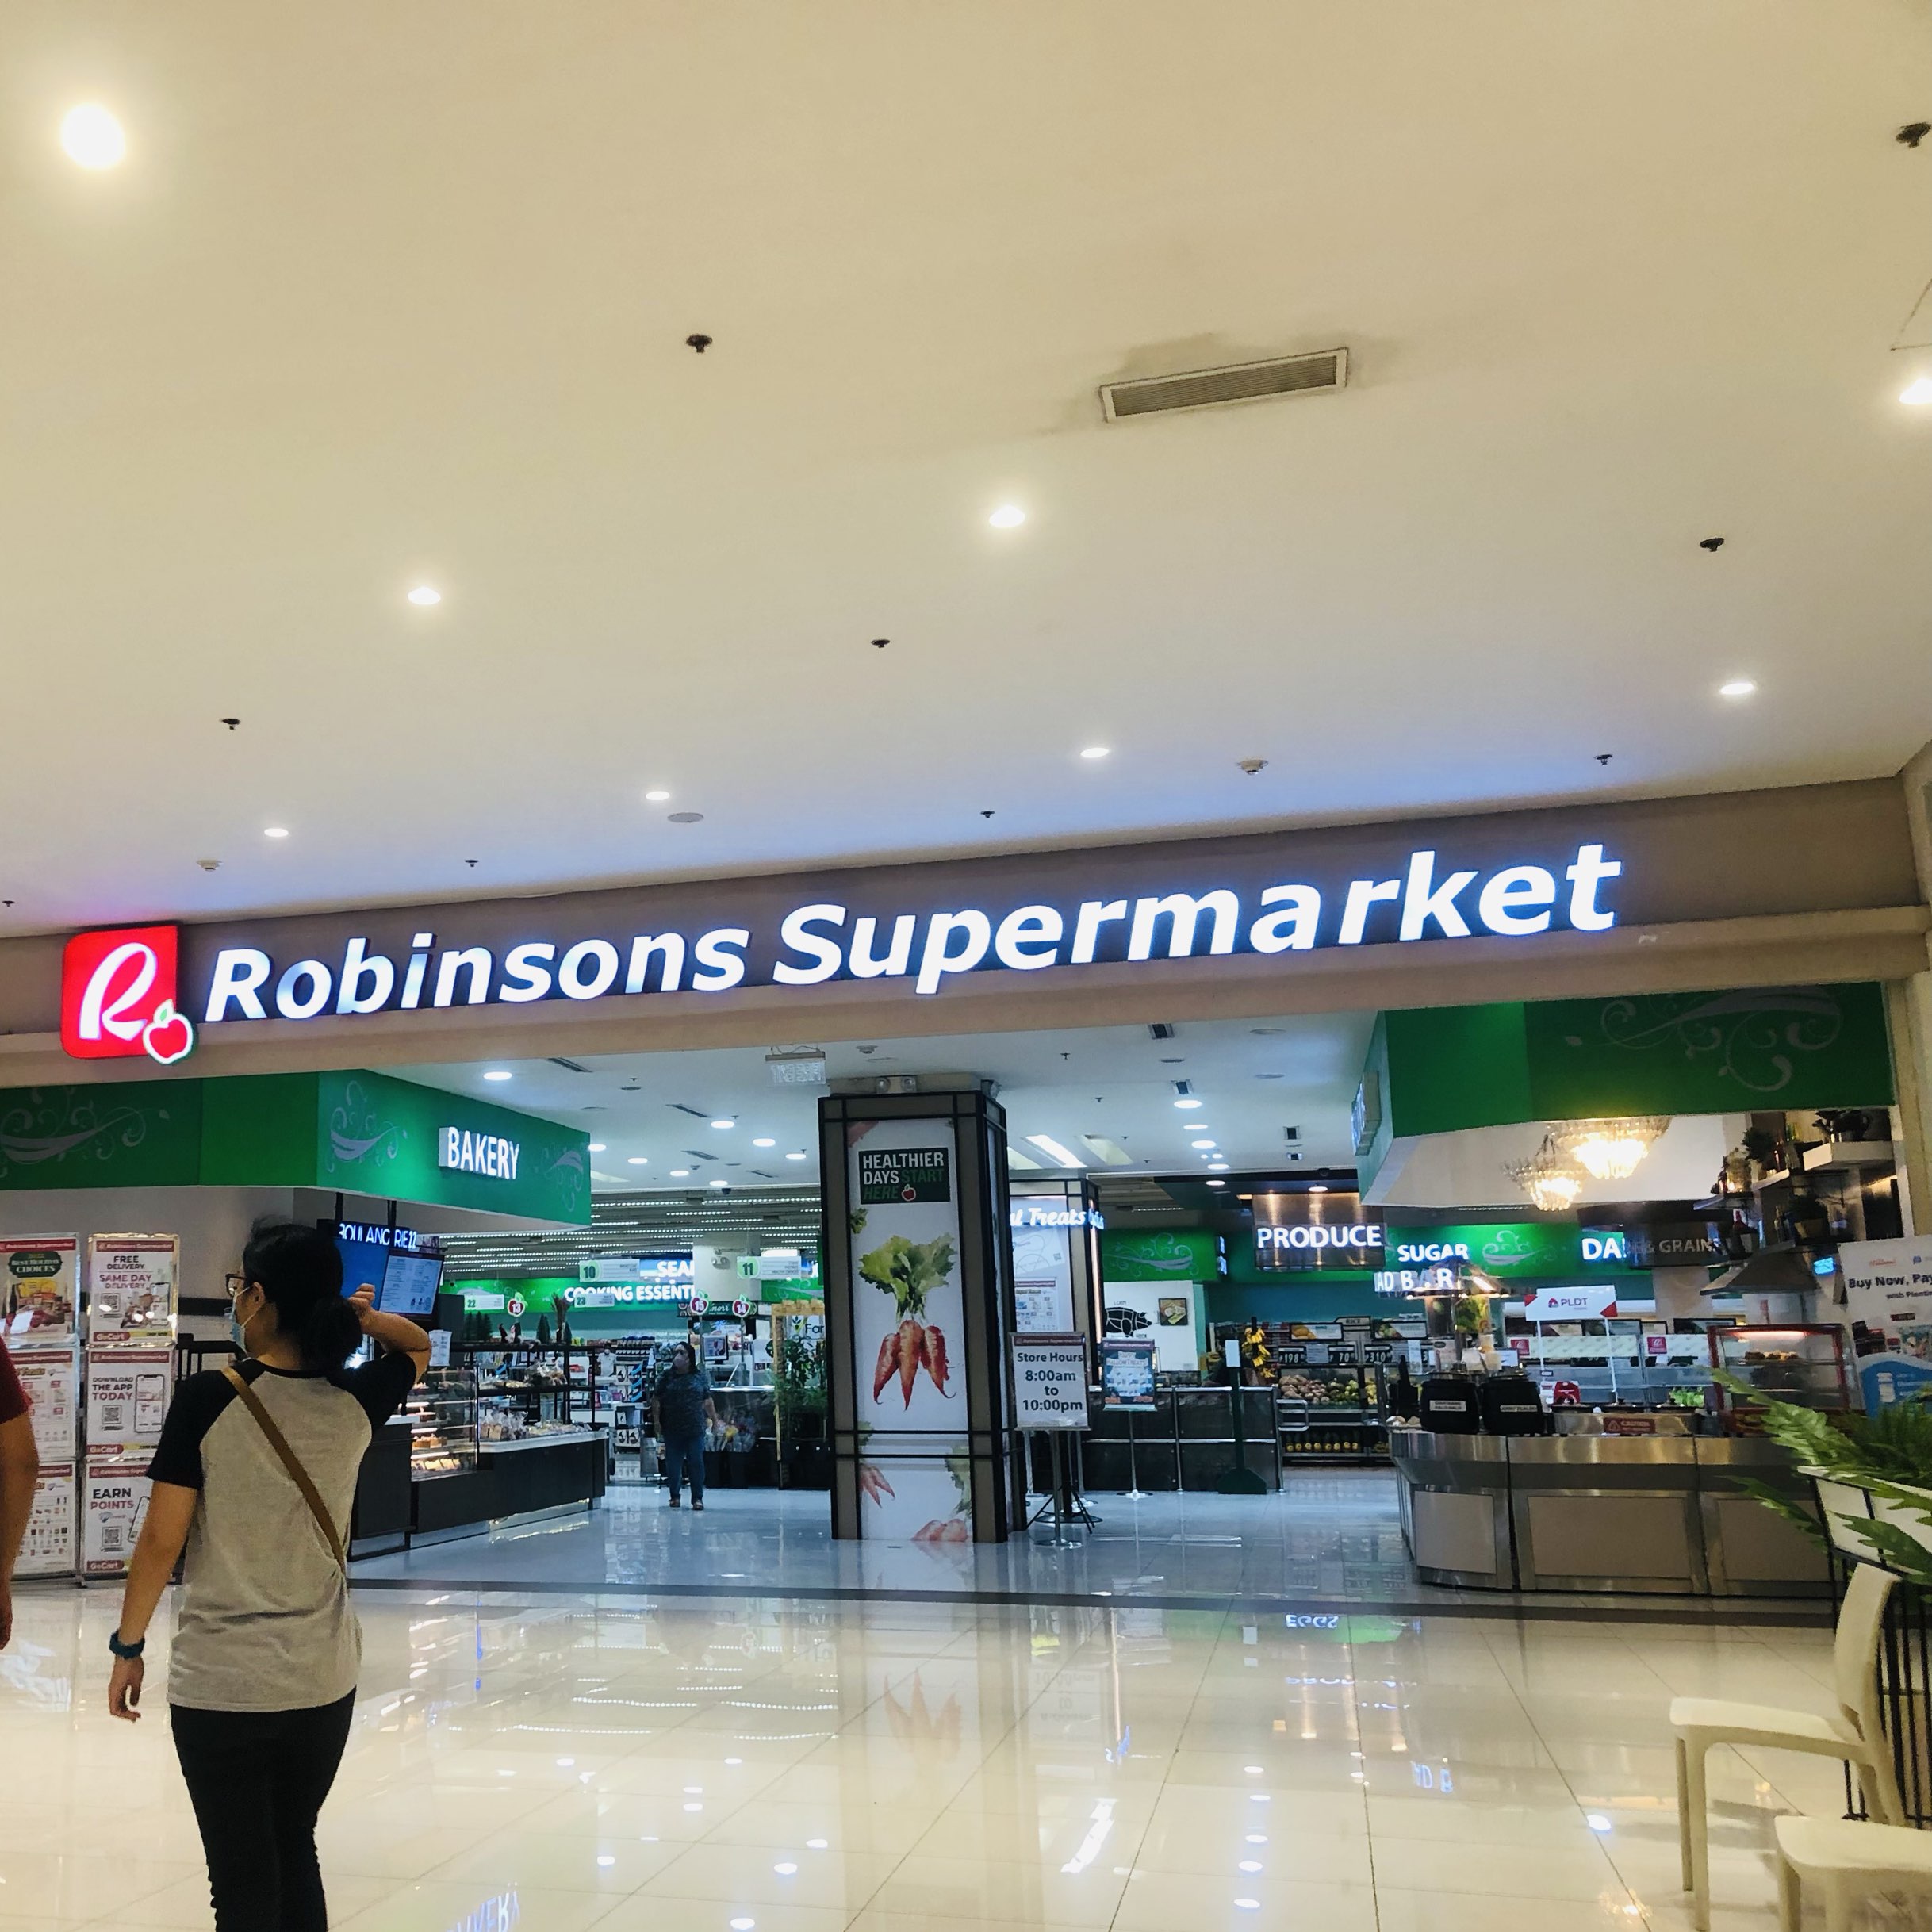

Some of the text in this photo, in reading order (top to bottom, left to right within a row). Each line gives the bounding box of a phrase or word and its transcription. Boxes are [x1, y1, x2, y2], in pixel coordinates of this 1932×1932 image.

[205, 927, 750, 1023] Robinsons
[772, 844, 1623, 995] Supermarket
[444, 1126, 520, 1180] BAKERY
[863, 1152, 944, 1169] HEALTHIER
[864, 1169, 944, 1185] DAYS START
[863, 1186, 899, 1200] HERE
[1028, 1207, 1087, 1226] Treats
[1257, 1225, 1382, 1248] PRODUCE
[1397, 1244, 1469, 1262] SUGAR
[583, 1266, 596, 1279] 10
[742, 1263, 753, 1276] 11
[99, 1274, 152, 1282] SAME DAY
[1848, 1278, 1872, 1290] Buy
[467, 1299, 476, 1308] 22
[577, 1297, 586, 1305] 23
[695, 1299, 704, 1311] 15
[1560, 1298, 1588, 1307] PLDT
[708, 1303, 730, 1312] norr
[737, 1303, 746, 1313] 14
[805, 1324, 825, 1334] Far
[1017, 1352, 1083, 1363] Store Hours
[1025, 1370, 1076, 1382] 8:00am
[92, 1392, 133, 1401] TODAY
[1044, 1386, 1059, 1396] to
[1022, 1399, 1083, 1413] 10:00pm
[93, 1488, 132, 1499] EARN
[90, 1500, 134, 1510] POINTS
